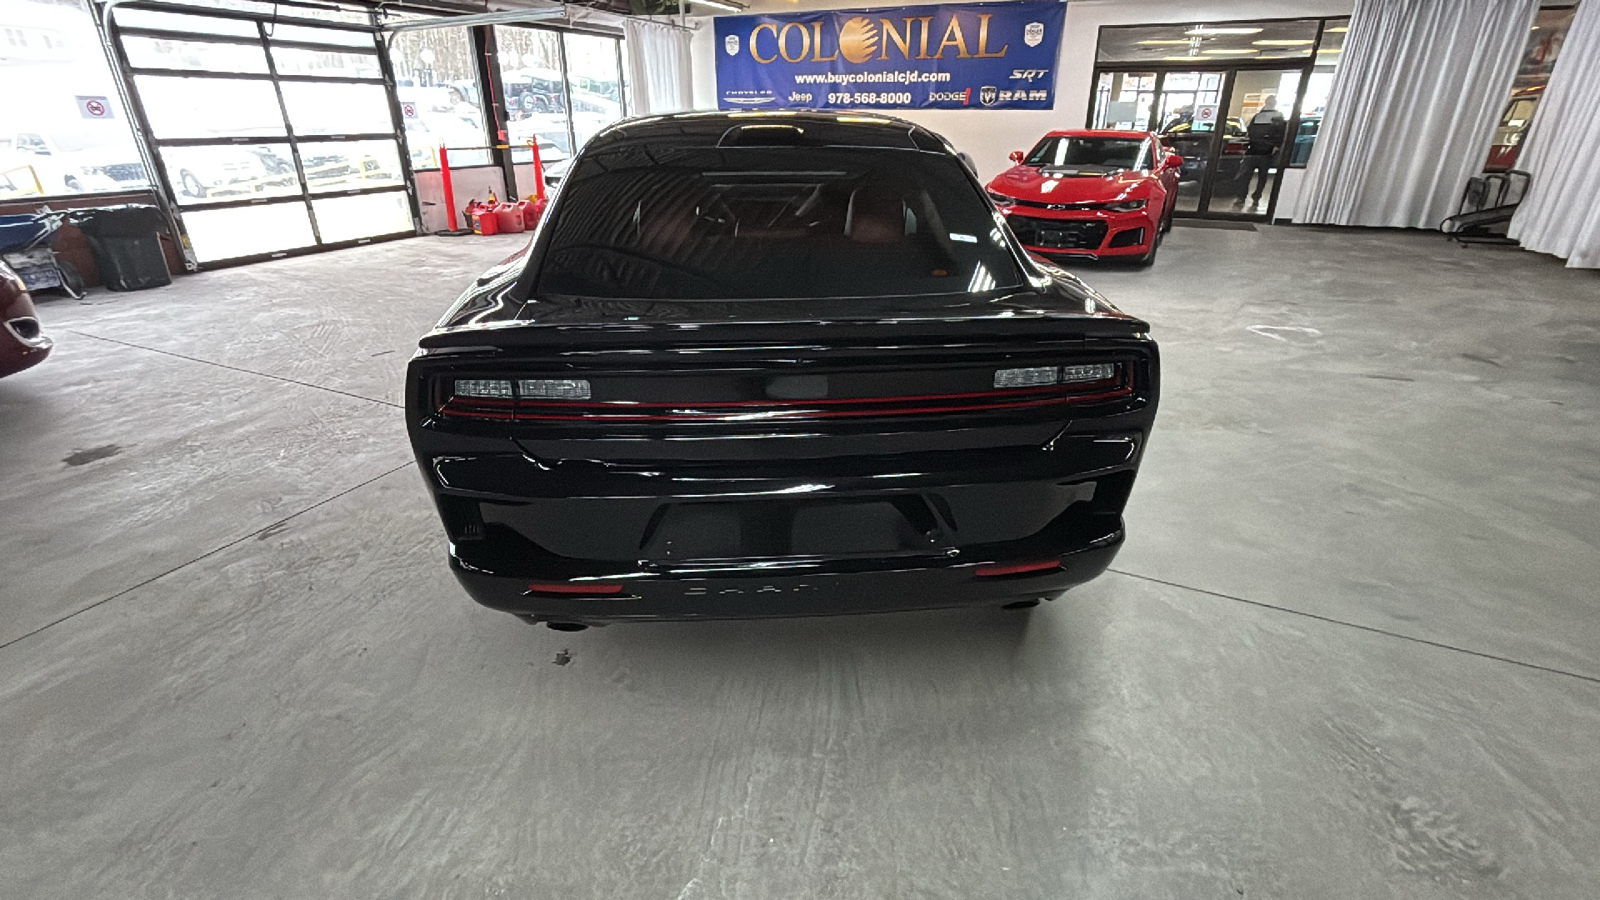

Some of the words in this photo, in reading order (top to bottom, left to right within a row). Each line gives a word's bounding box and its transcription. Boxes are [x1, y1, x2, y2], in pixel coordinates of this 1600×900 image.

[749, 13, 1008, 64] COLONIAL
[795, 70, 951, 86] www.buycolonialcjd.com
[1009, 69, 1049, 83] SRT
[788, 91, 813, 103] Jeep
[827, 92, 912, 105] 978-568-8000
[929, 91, 967, 102] DODGE
[999, 89, 1048, 101] RAM
